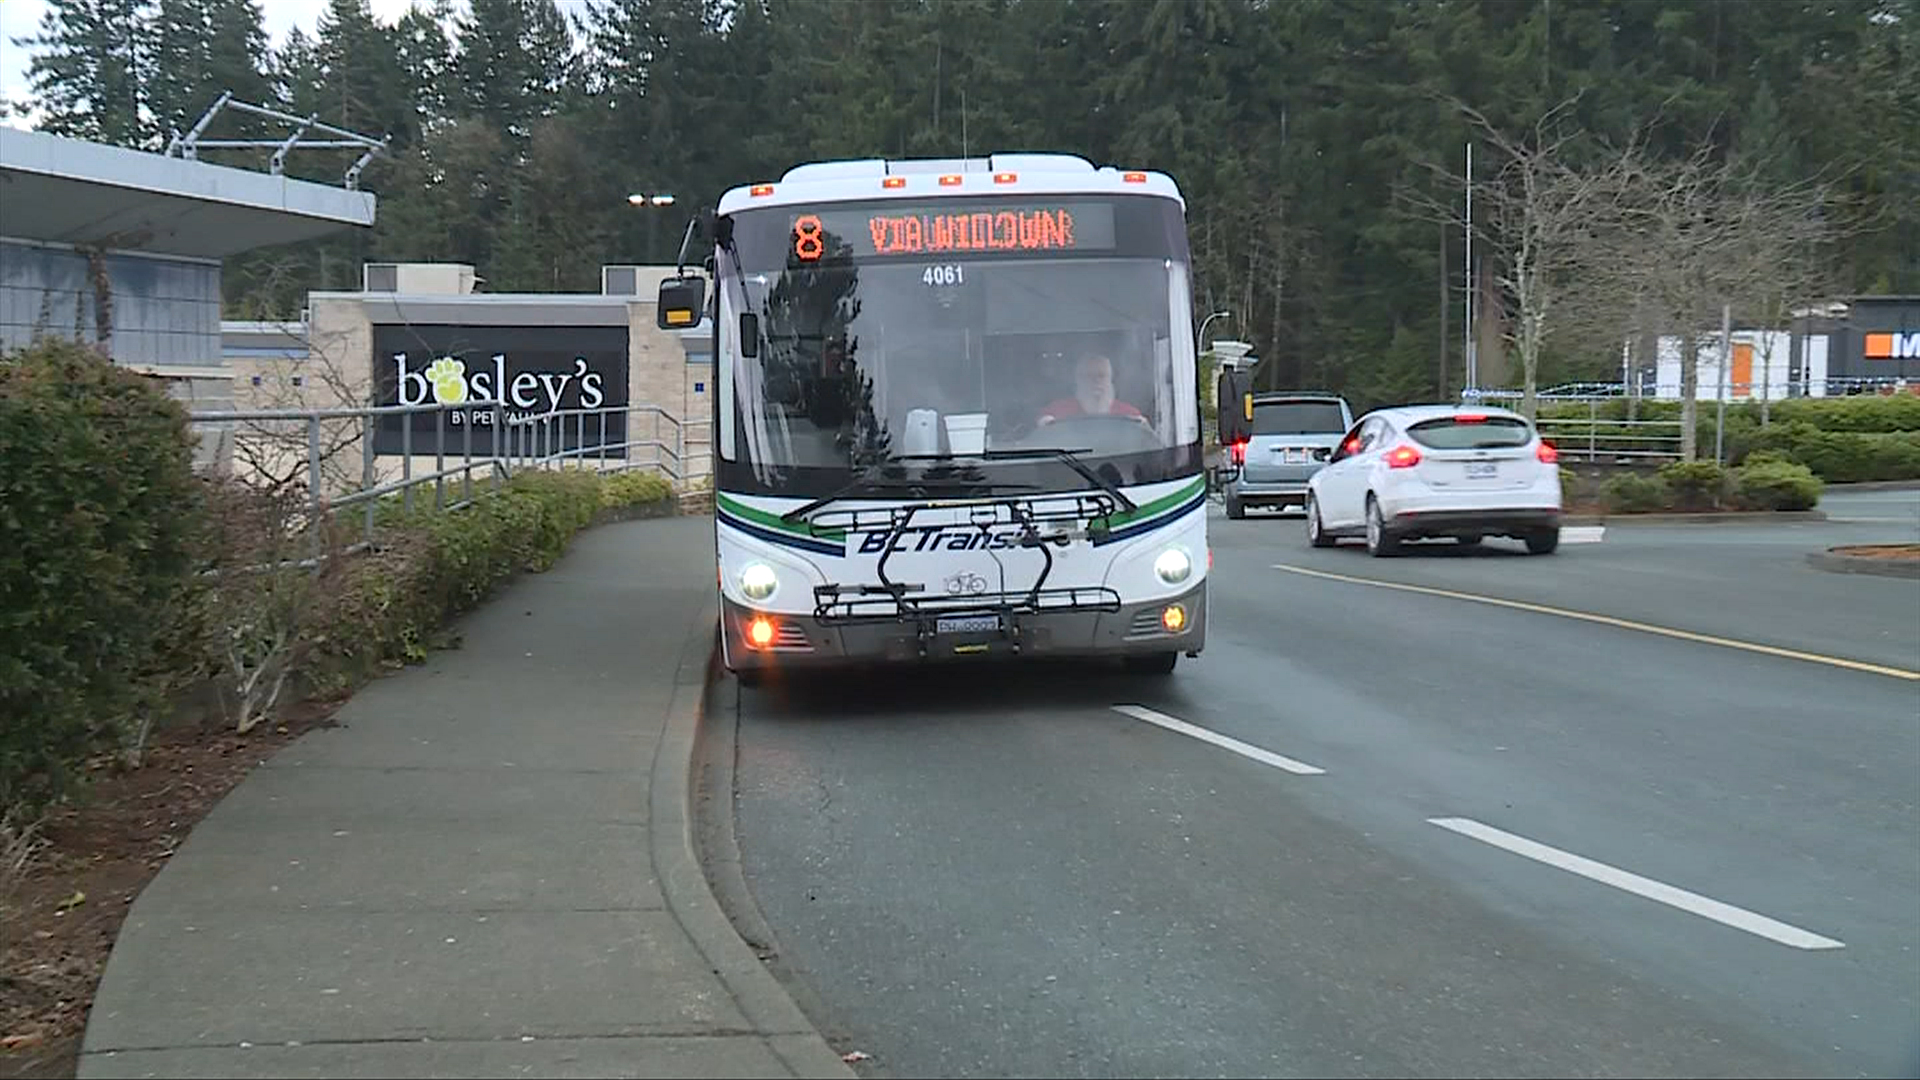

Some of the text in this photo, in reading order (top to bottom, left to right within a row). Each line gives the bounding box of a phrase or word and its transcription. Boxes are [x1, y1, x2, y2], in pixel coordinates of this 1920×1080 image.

[794, 214, 823, 261] 8
[922, 266, 964, 286] 4061
[394, 354, 604, 413] bosley's
